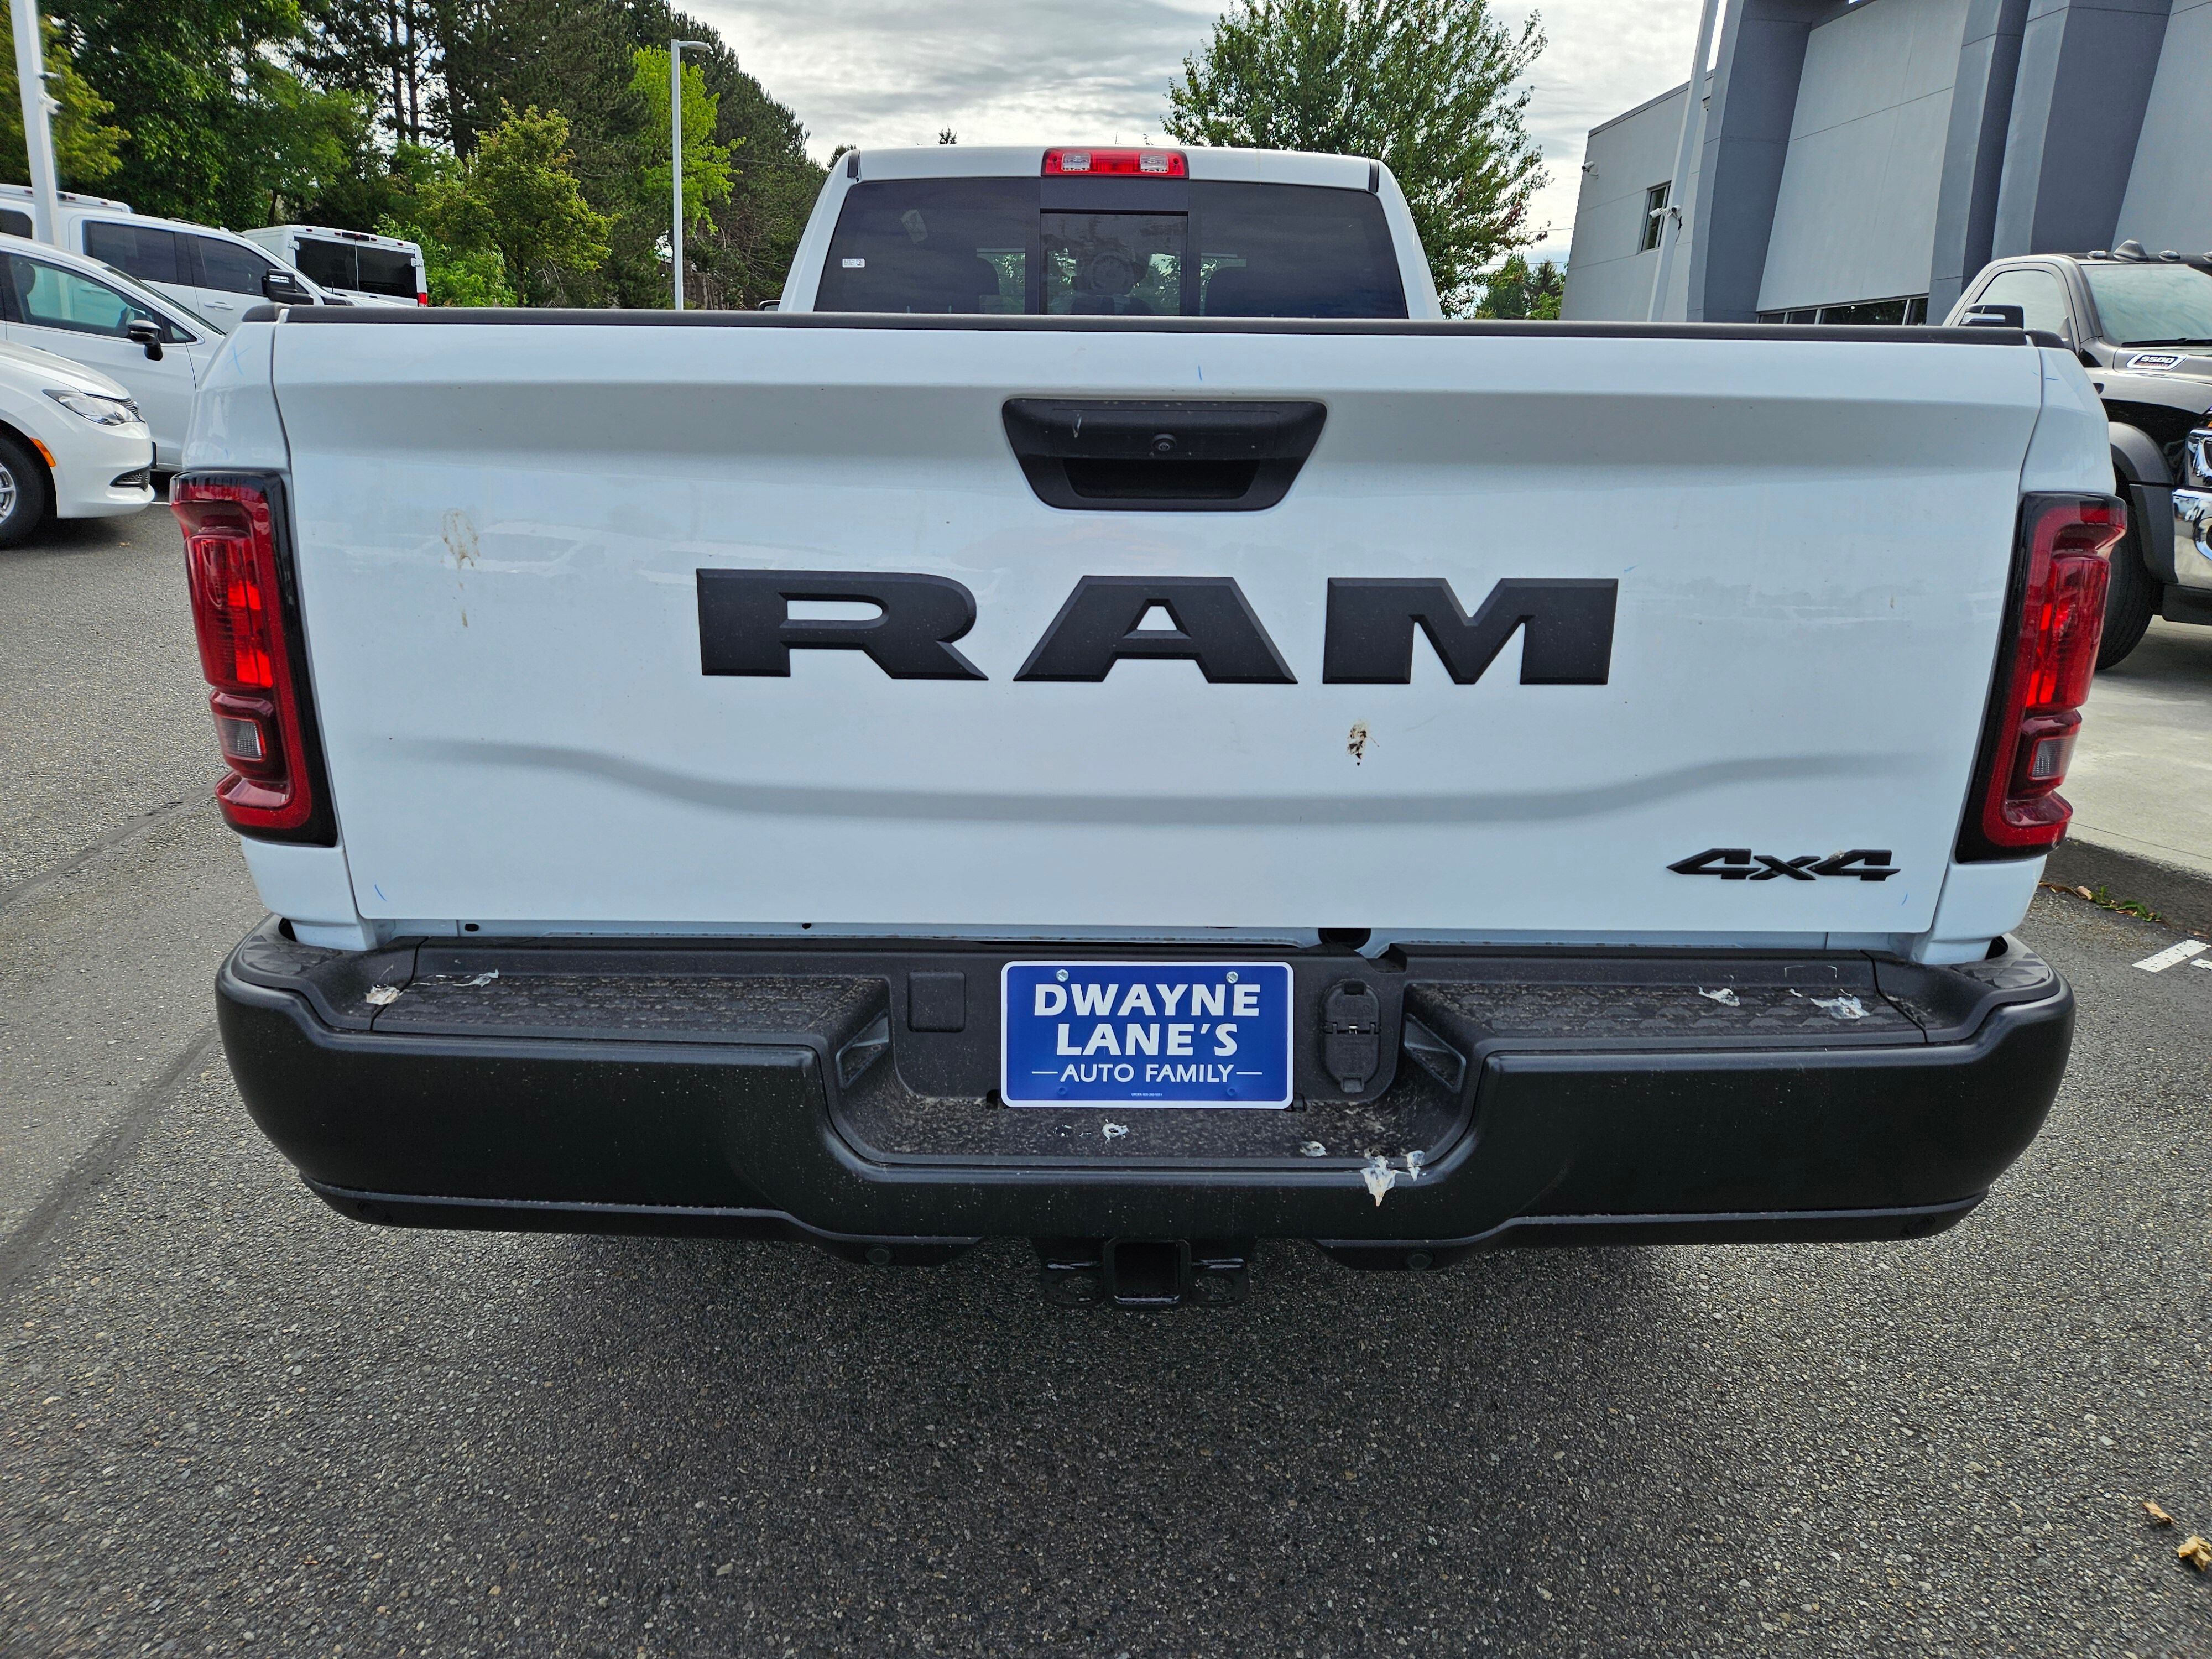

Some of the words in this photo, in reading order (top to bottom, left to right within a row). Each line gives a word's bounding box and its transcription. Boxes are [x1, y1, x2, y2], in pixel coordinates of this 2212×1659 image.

[696, 568, 1619, 686] RAM
[1034, 984, 1260, 1016] DWAYNE
[1056, 1023, 1238, 1056] LANE'S
[1060, 1063, 1134, 1082] AUTO
[1146, 1064, 1234, 1082] FAMILY
